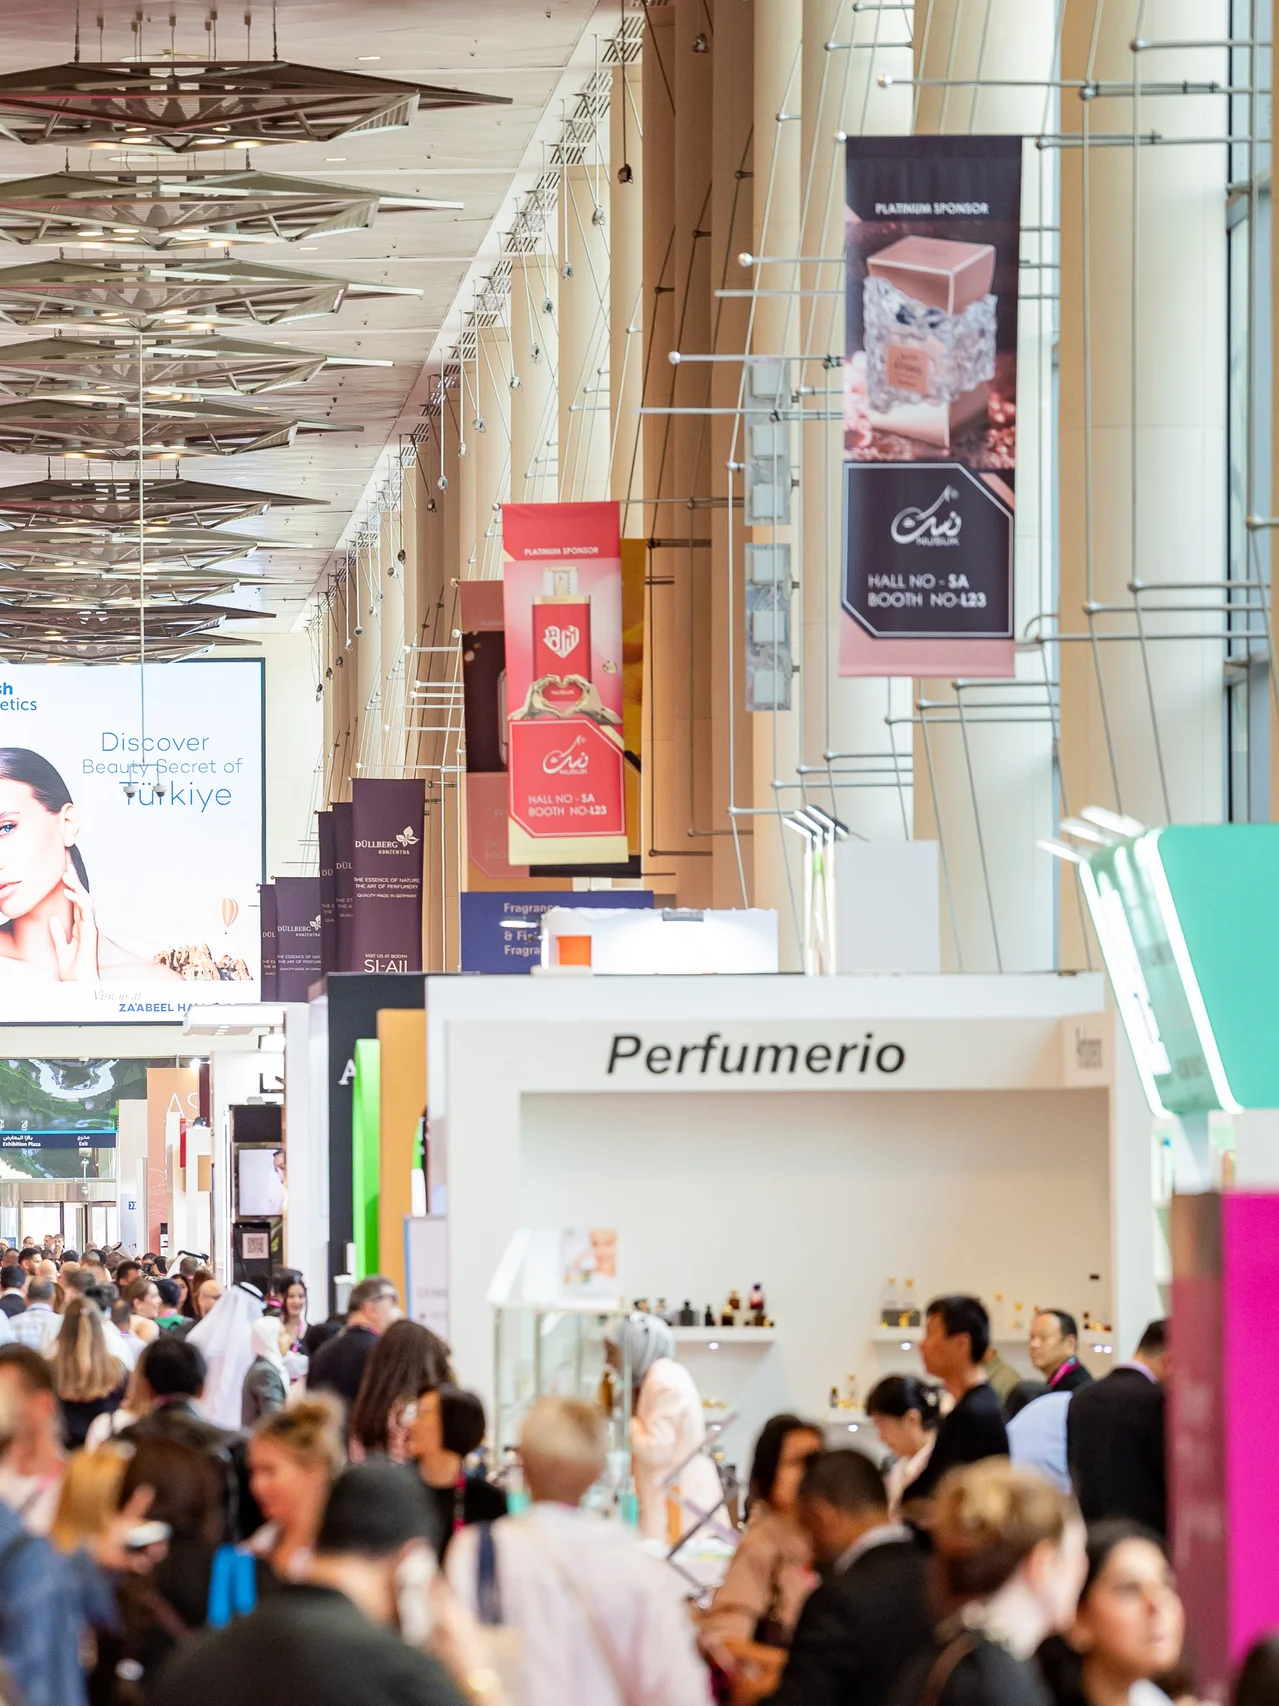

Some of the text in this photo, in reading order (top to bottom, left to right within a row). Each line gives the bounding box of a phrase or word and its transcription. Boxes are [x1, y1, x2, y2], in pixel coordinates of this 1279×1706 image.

[875, 202, 989, 215] PLATINUM SPONSOR
[524, 547, 599, 556] PLATINUM SPONSOR
[868, 573, 907, 589] HALL
[909, 573, 936, 589] NO
[948, 573, 970, 589] SA
[868, 592, 923, 607] BOOTH
[102, 732, 209, 751] Discover
[82, 758, 243, 777] Beauty Secret of
[528, 795, 552, 804] HALL
[555, 794, 573, 803] NO
[581, 794, 595, 803] SA
[528, 806, 564, 817] BOOTH
[355, 840, 398, 848] DÜLLBERG
[607, 1031, 906, 1074] Perfumerio
